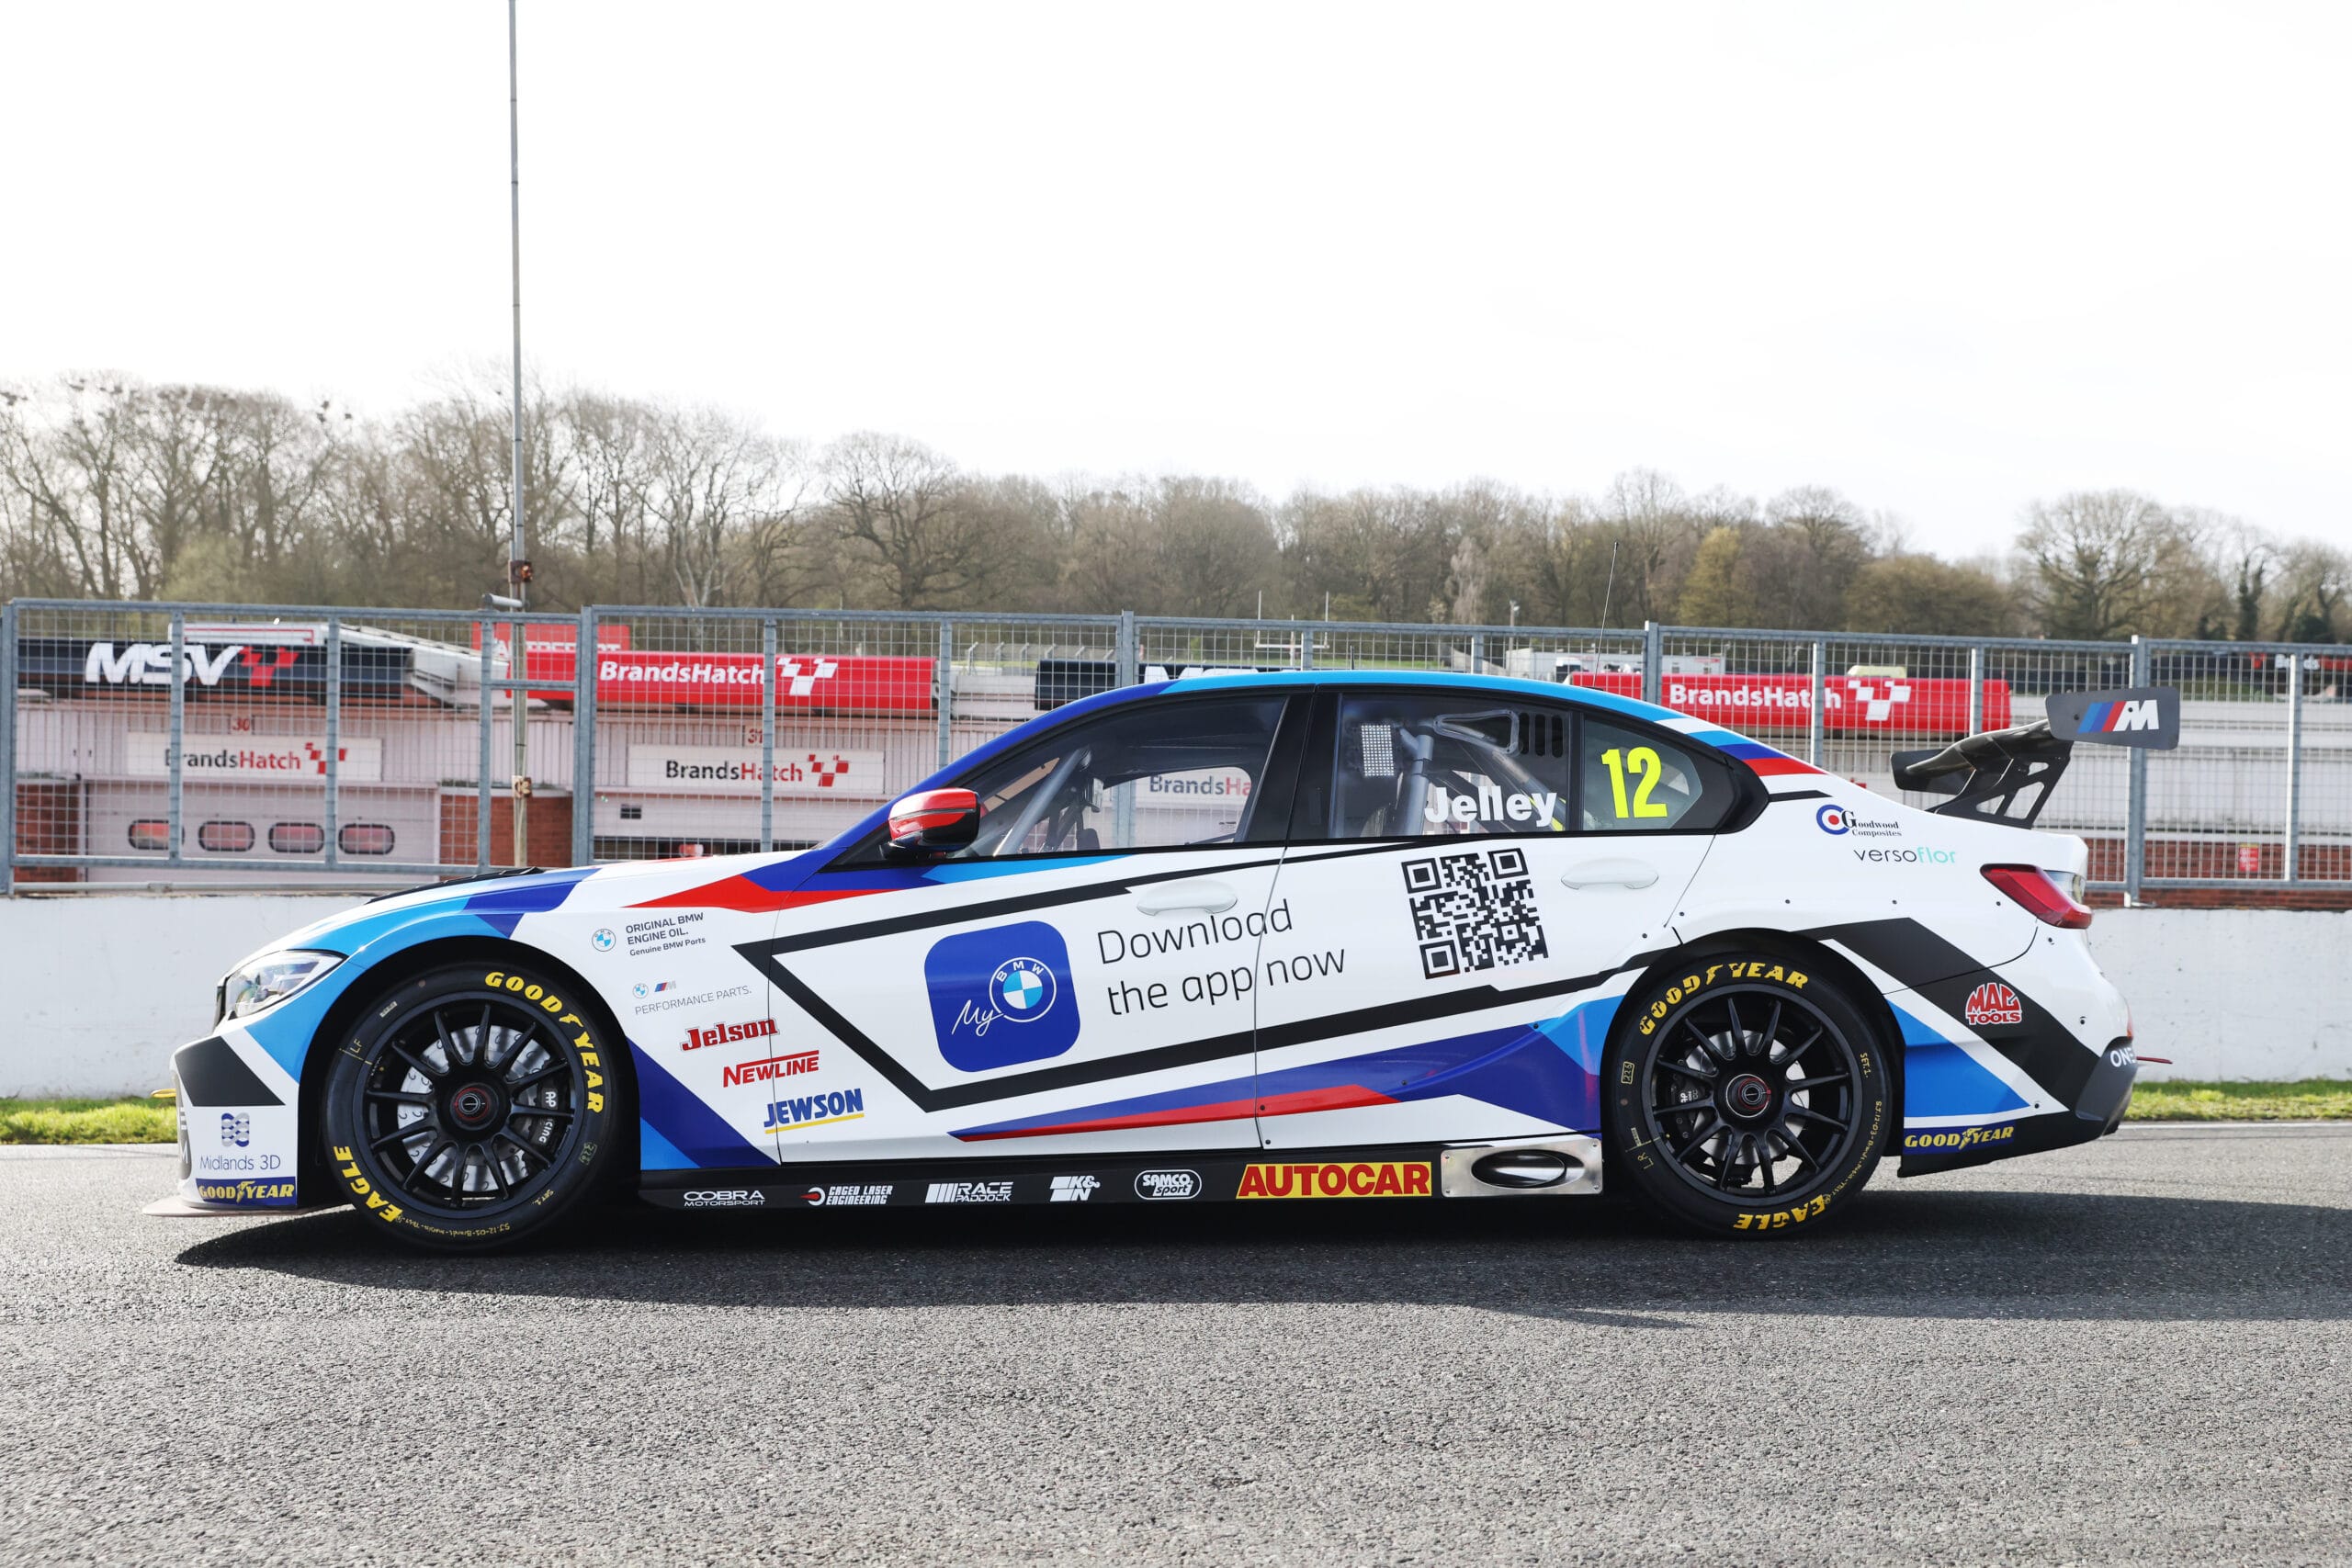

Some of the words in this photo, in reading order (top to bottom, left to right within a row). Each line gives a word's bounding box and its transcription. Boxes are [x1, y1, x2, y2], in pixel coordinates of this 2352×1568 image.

[85, 642, 244, 685] MSV
[600, 660, 764, 684] BrandsHatch
[1669, 683, 1842, 709] BrandsHath
[2113, 699, 2159, 732] M
[164, 749, 301, 770] andsHatch
[1600, 747, 1668, 818] 12
[1424, 785, 1557, 827] Jelley
[1841, 810, 1899, 829] Goodwood
[1852, 829, 1902, 837] Composites
[1853, 847, 1956, 863] versoflor
[626, 918, 675, 934] ORIGINAL
[677, 912, 704, 924] BMW
[1098, 898, 1293, 964] Download
[628, 930, 666, 945] ENGINE
[669, 927, 689, 937] OIL.
[629, 945, 662, 956] Genuine
[662, 941, 684, 951] BMW
[684, 937, 706, 947] Parts
[996, 960, 1044, 982] BMW
[1107, 980, 1169, 1015] the
[1182, 966, 1252, 1006] app
[1266, 949, 1344, 986] now
[635, 992, 715, 1015] PERFORMANCE
[717, 985, 752, 999] PARTS.
[1967, 983, 2020, 1011] MAC
[951, 999, 1003, 1037] My
[1967, 1011, 2020, 1024] TOOLS
[682, 1019, 778, 1051] Jelson
[723, 1050, 819, 1088] NEWLINE
[763, 1088, 864, 1128] JEWSON
[200, 1155, 254, 1170] Midlands
[260, 1155, 280, 1170] 3D
[333, 1146, 402, 1223] EAGLE
[828, 1186, 859, 1196] CAGED
[863, 1185, 893, 1195] LASER
[957, 1181, 1013, 1195] RACE
[1143, 1174, 1191, 1187] SAMCO
[1156, 1185, 1188, 1196] sport
[1238, 1164, 1430, 1197] AUTOCAR
[684, 1190, 764, 1201] COBRA
[826, 1194, 888, 1205] ENGINEERING
[955, 1194, 1011, 1203] PADDOCK
[1733, 1194, 1826, 1230] EAGLE
